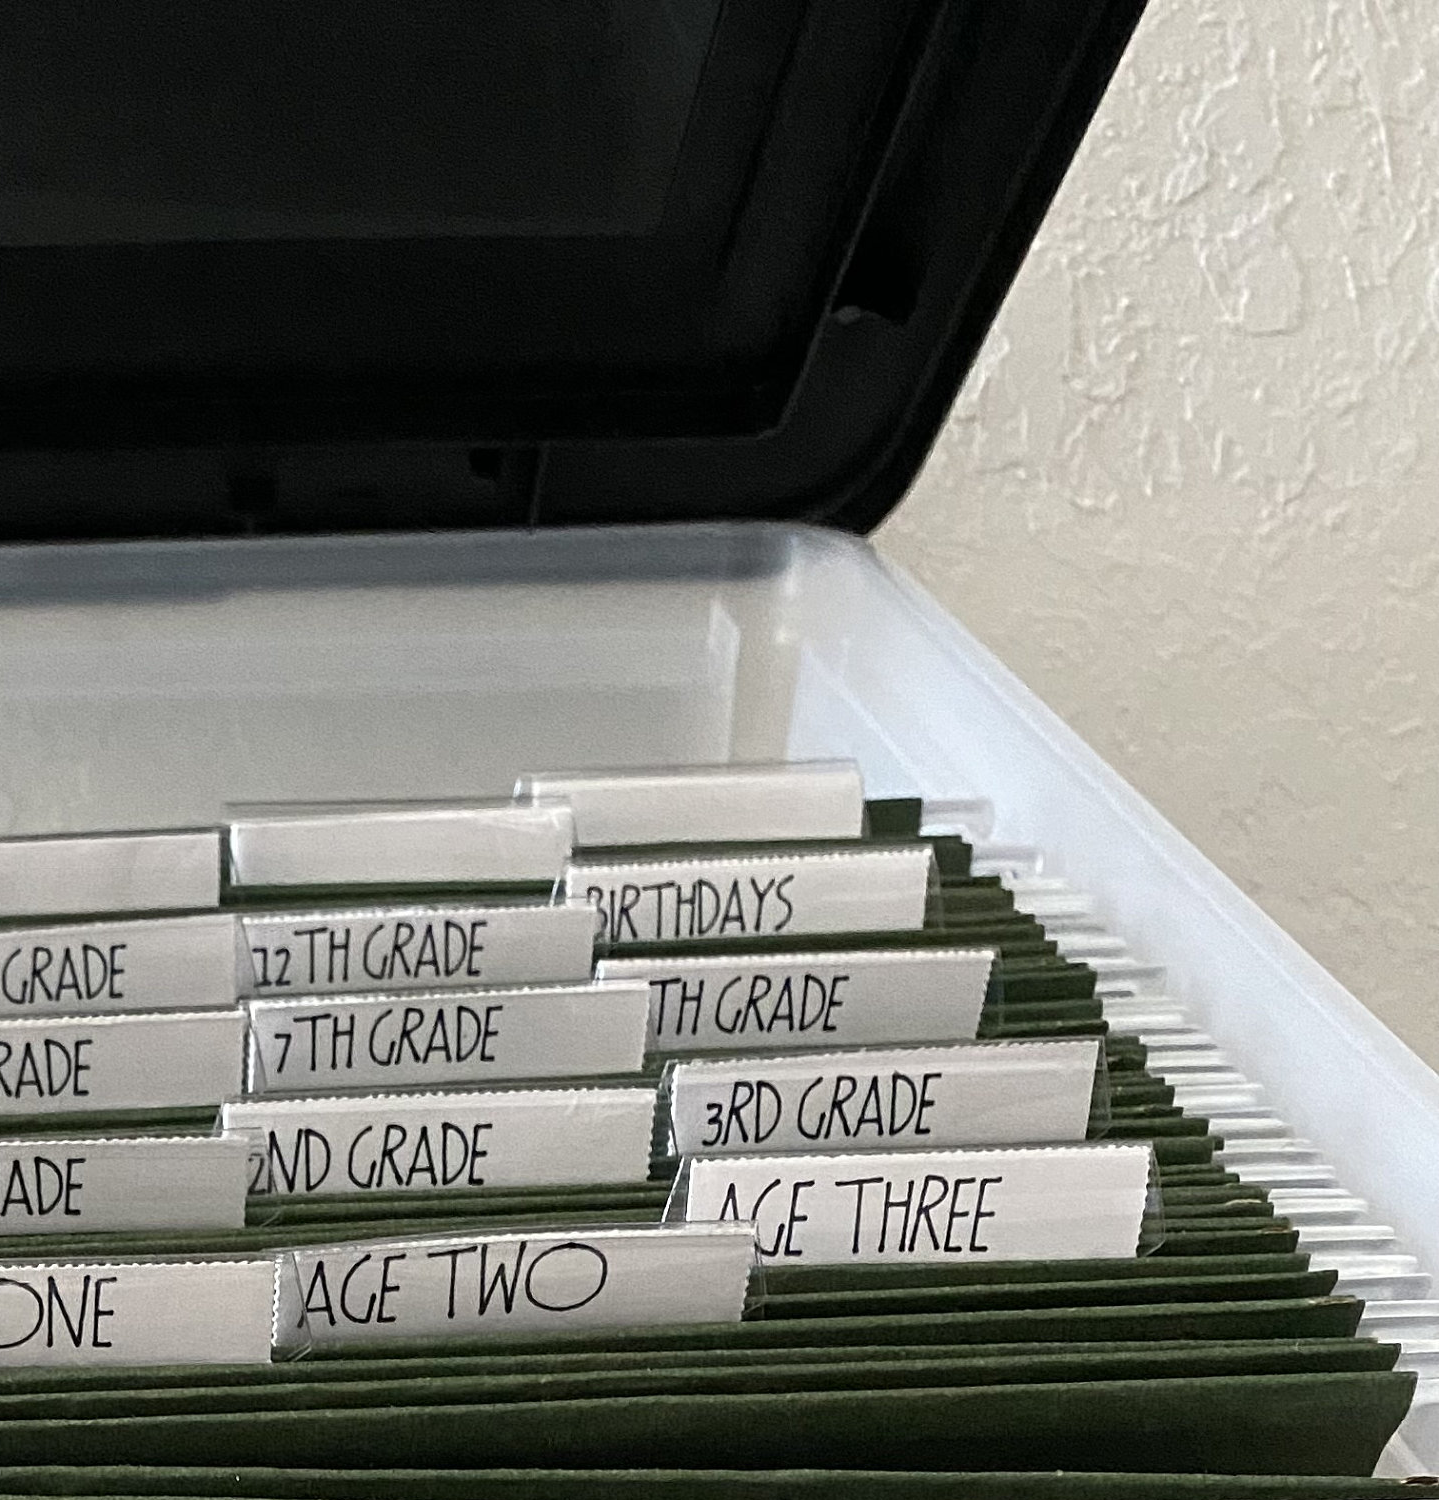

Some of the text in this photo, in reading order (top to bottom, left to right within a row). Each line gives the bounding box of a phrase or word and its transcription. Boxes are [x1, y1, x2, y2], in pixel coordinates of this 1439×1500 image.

[586, 873, 796, 943] BIRTHDAYS
[1, 944, 127, 1005] GRADE
[252, 920, 488, 988] 12TH GRADE
[274, 1004, 504, 1073] 7TH GRADE
[649, 973, 851, 1036] TH GRADE
[701, 1072, 942, 1147] 3RD GRADE
[247, 1121, 493, 1194] 2ND GRADE
[835, 1174, 1003, 1255] THREE
[296, 1240, 609, 1328] AGE TWO
